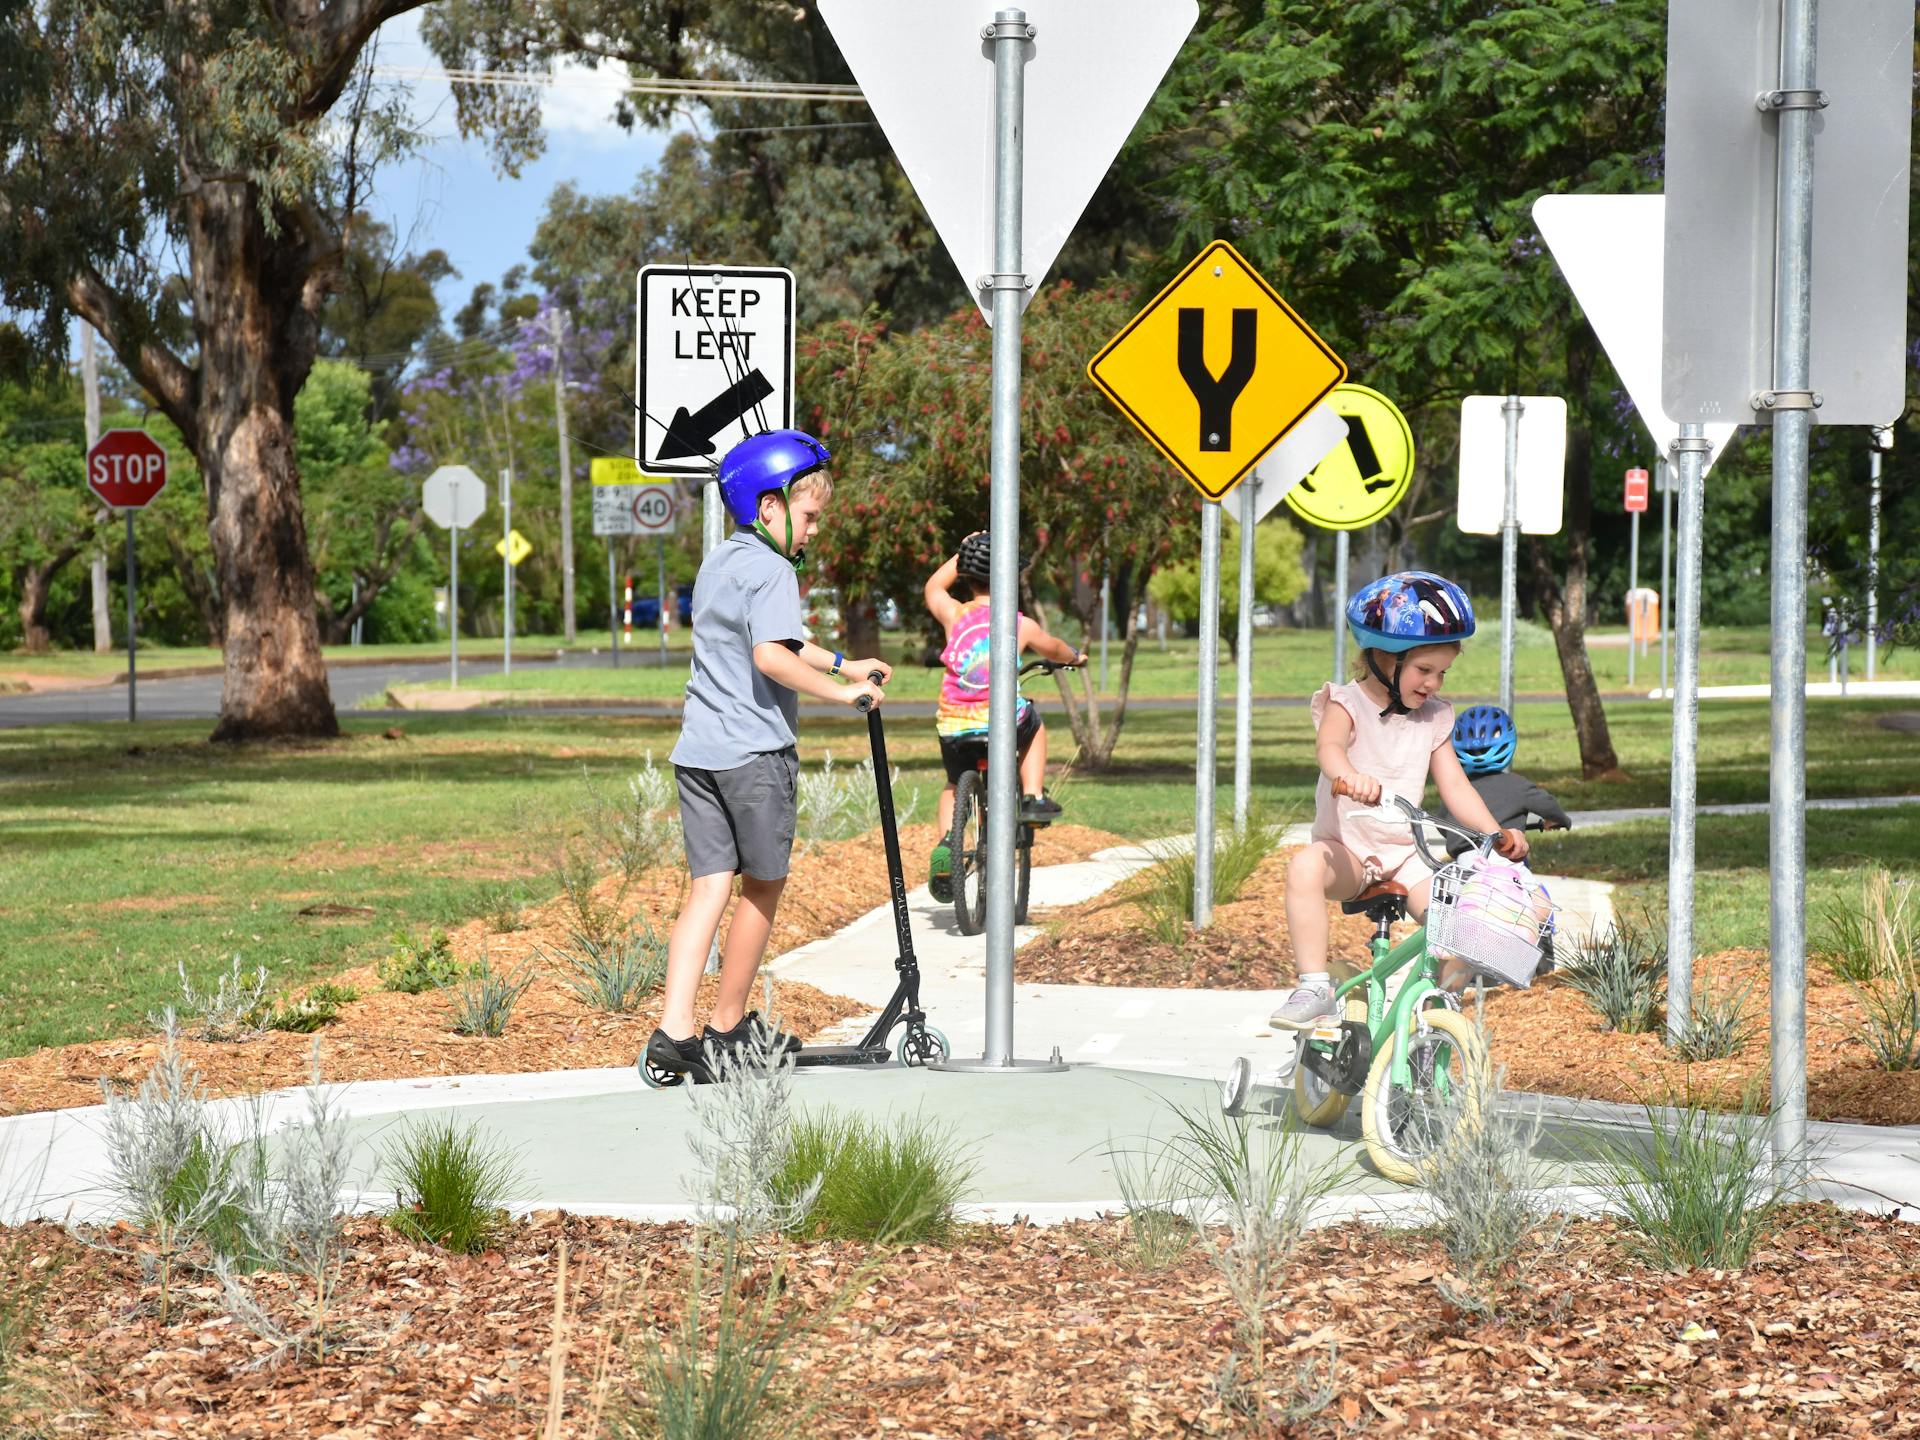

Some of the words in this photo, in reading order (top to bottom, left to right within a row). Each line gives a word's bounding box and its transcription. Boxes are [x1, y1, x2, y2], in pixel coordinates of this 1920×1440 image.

[672, 288, 760, 318] KEEP
[675, 330, 756, 360] LEFT
[93, 454, 162, 484] STOP
[640, 499, 667, 517] 40
